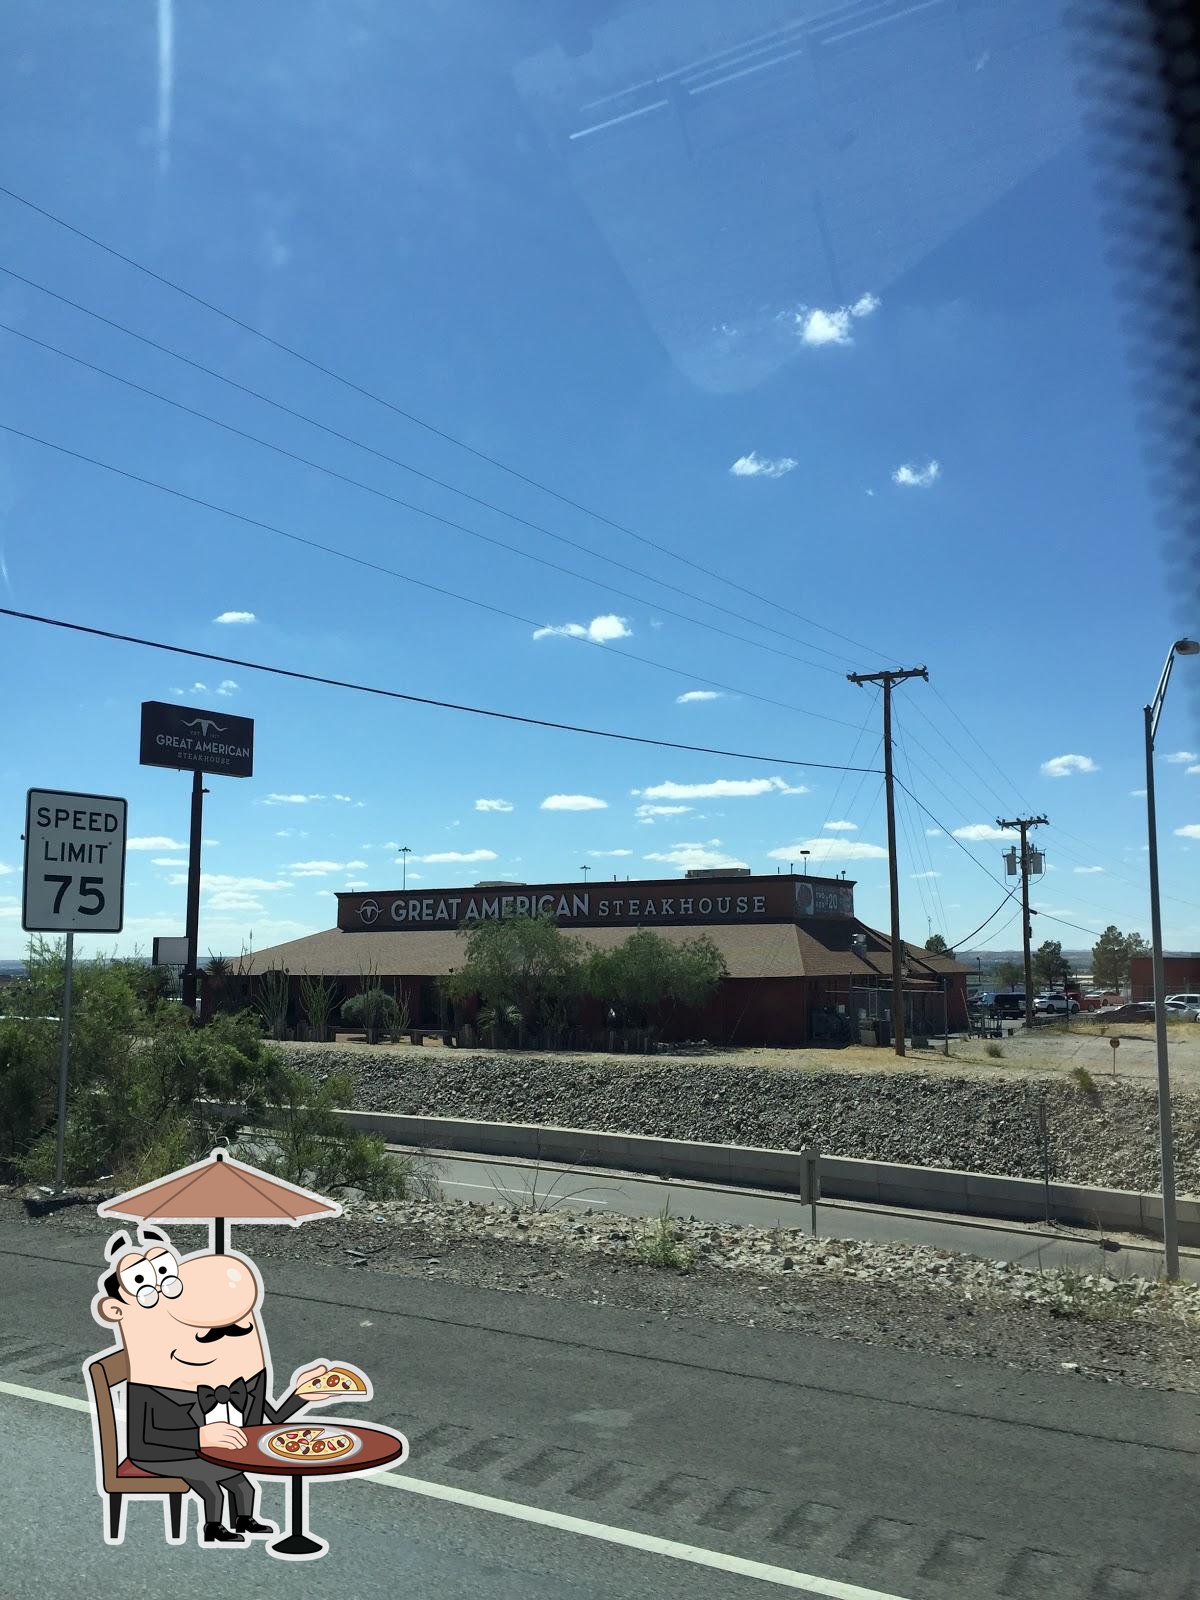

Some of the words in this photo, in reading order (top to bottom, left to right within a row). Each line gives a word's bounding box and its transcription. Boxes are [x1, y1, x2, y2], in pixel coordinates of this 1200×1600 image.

[156, 734, 193, 749] GREAT
[195, 741, 250, 758] AMERICAN
[177, 752, 230, 765] STEAKHOUSE
[37, 807, 118, 833] SPEED
[44, 841, 108, 864] LIMIT
[44, 874, 106, 915] 75
[390, 898, 462, 921] GREAT
[464, 893, 589, 920] AMERICAN
[598, 896, 766, 916] STEAKHOUSE
